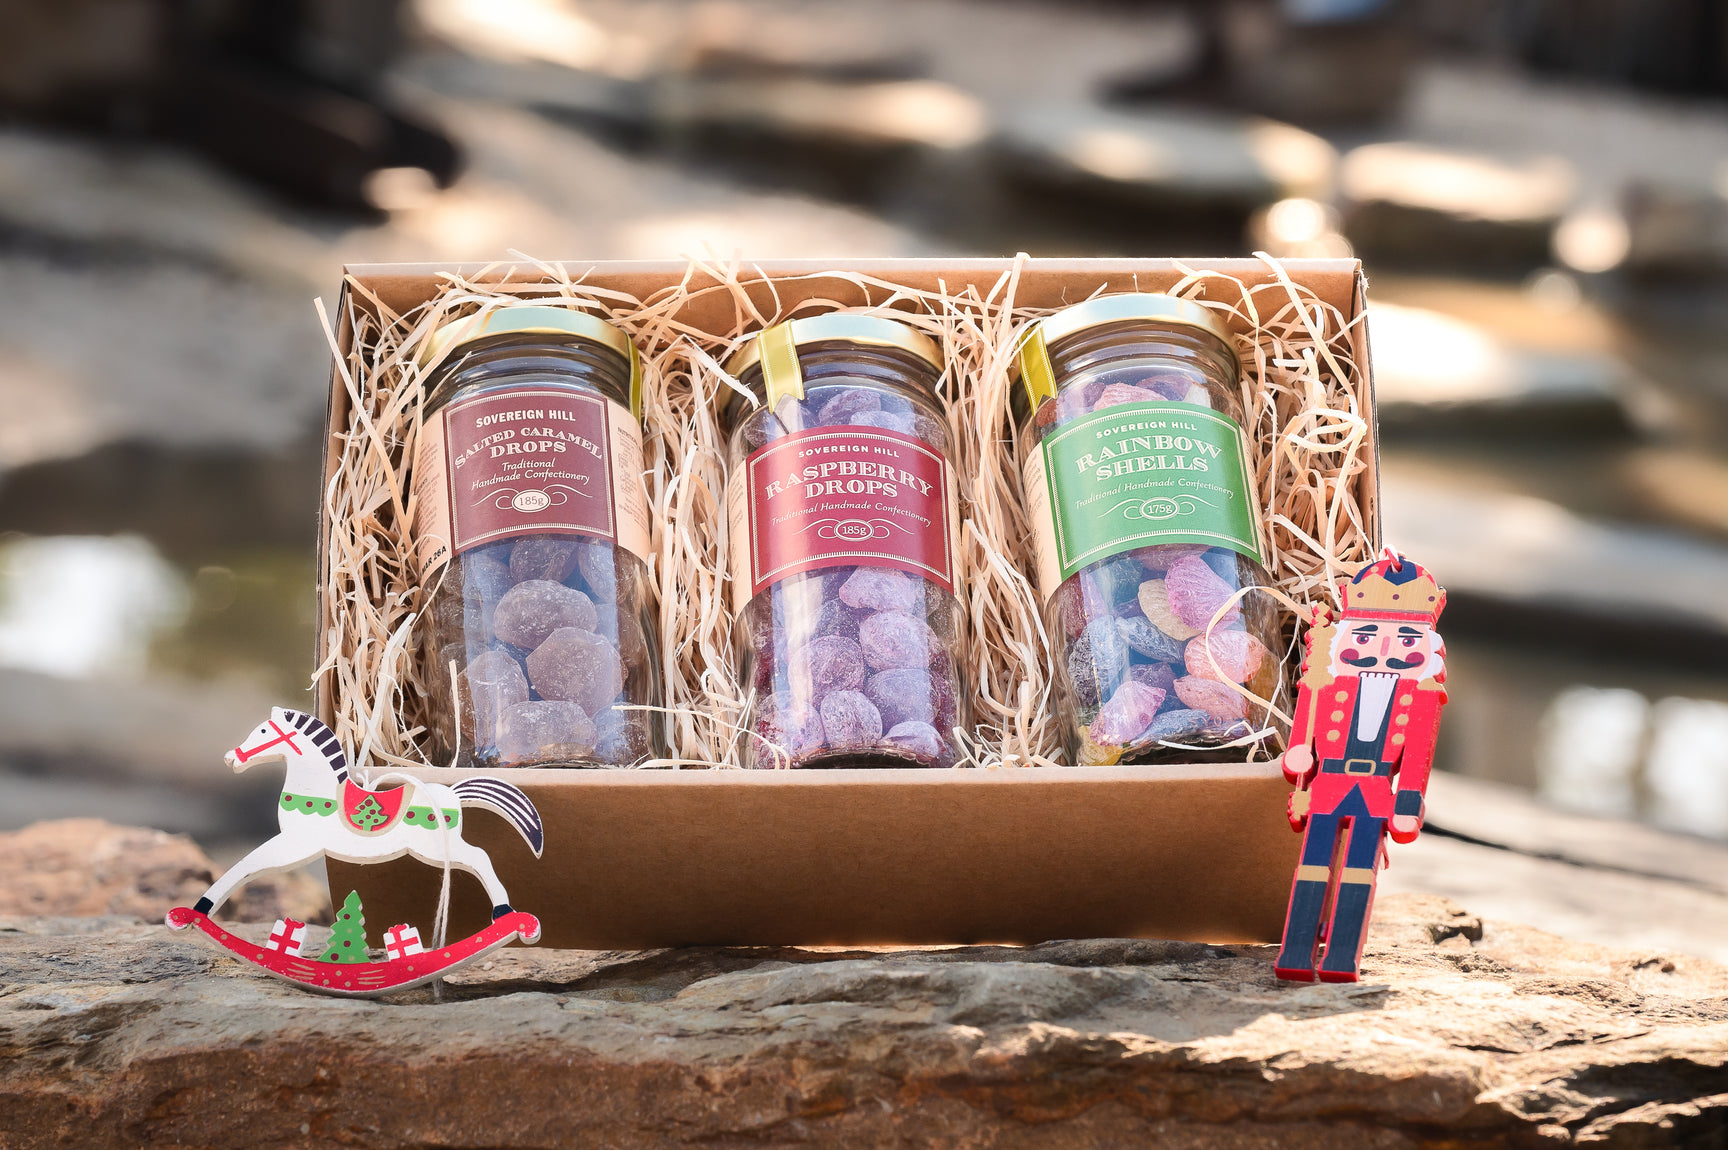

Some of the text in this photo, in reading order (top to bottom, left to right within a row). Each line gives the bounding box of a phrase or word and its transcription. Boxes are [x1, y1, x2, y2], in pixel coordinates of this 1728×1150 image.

[475, 410, 576, 428] SOVEREIGN HILL
[1095, 421, 1198, 439] SOVEREIGN HILL
[455, 429, 515, 469] SALTED
[520, 427, 602, 460] CARAMEL
[489, 440, 567, 459] DROPS
[798, 444, 900, 459] SOVEREIGN HILL
[1075, 434, 1223, 475] RAINBOW
[501, 457, 556, 472] Traditional
[1095, 455, 1209, 482] SHELLS
[471, 469, 590, 491] Handmade Confectionery
[764, 460, 934, 501] RASPBERRY
[804, 479, 898, 499] DROPS
[518, 494, 544, 506] 185g
[1075, 477, 1234, 510] Traditional Handmade Confectionery
[771, 502, 818, 527] Traditional
[820, 500, 872, 512] Handmade
[874, 502, 932, 528] Confectionery
[1148, 504, 1173, 515] 175g
[842, 526, 867, 536] 185g
